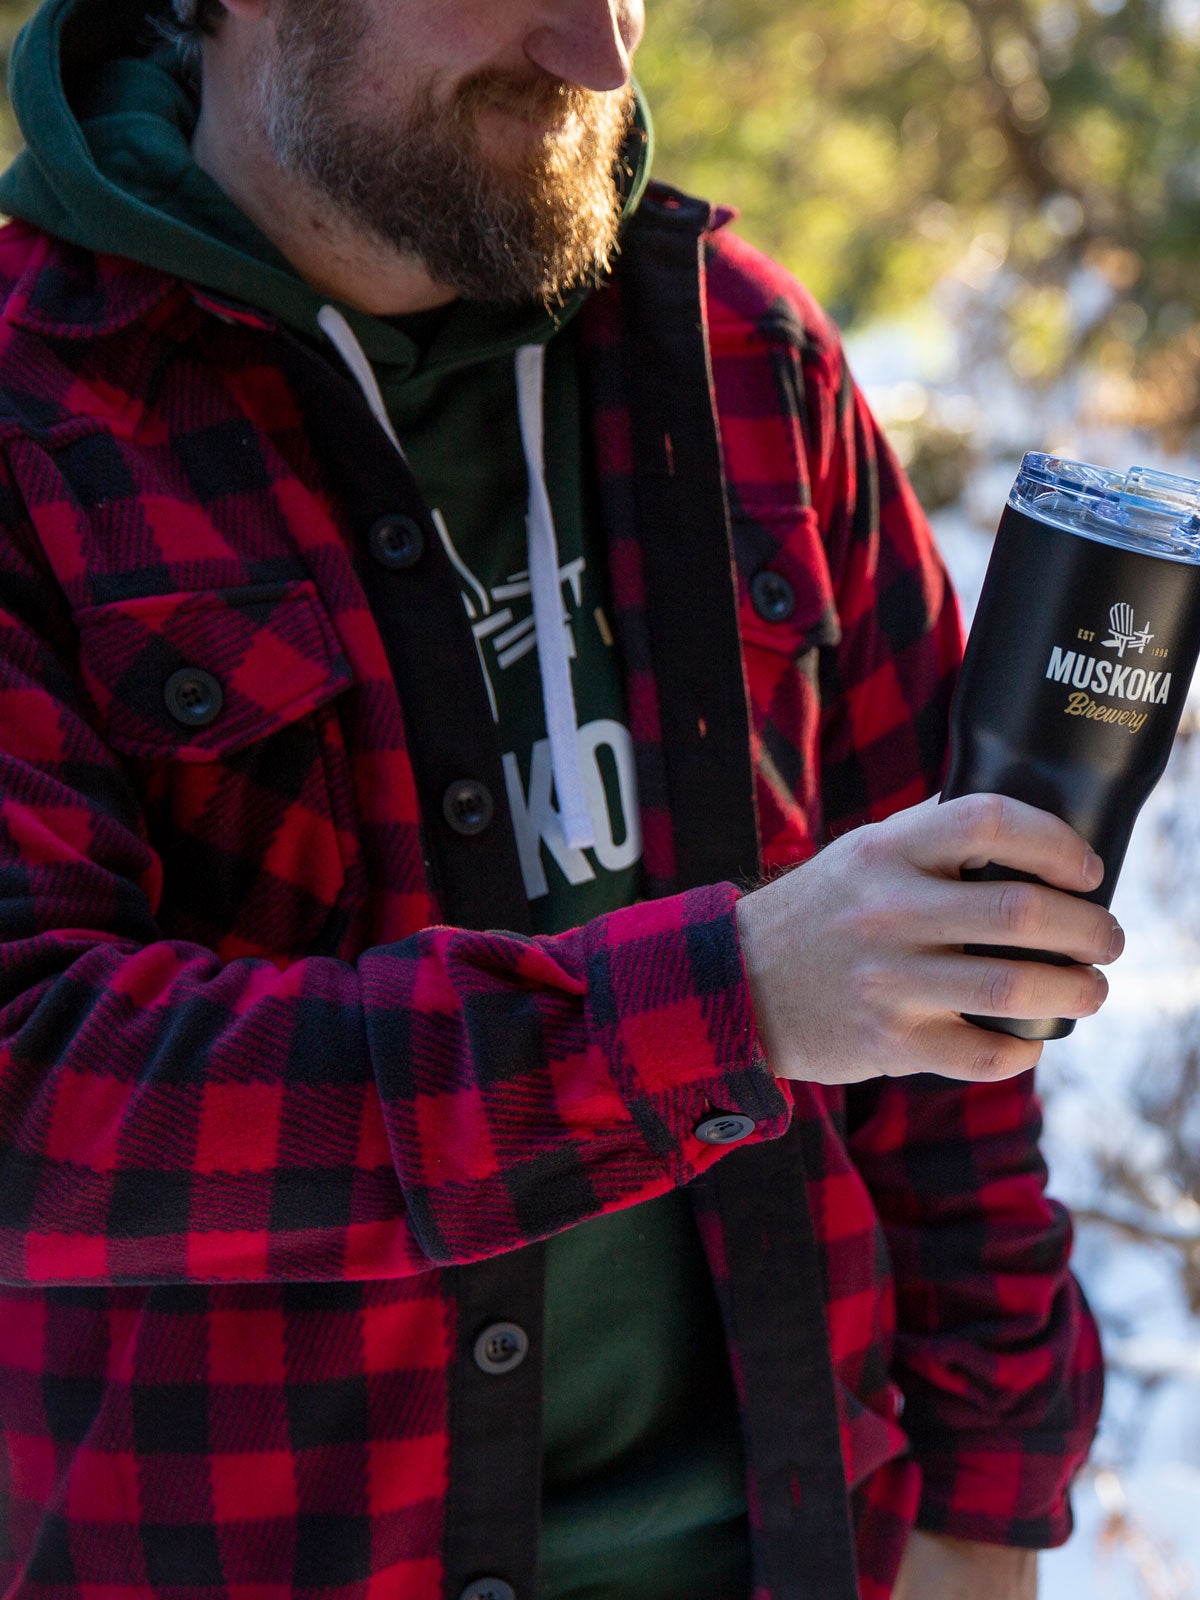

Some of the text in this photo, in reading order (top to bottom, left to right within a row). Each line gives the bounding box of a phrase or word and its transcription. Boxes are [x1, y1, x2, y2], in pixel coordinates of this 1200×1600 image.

[1077, 628, 1095, 642] EST
[1046, 646, 1172, 704] MUSKOKA
[1064, 692, 1148, 733] Brewery
